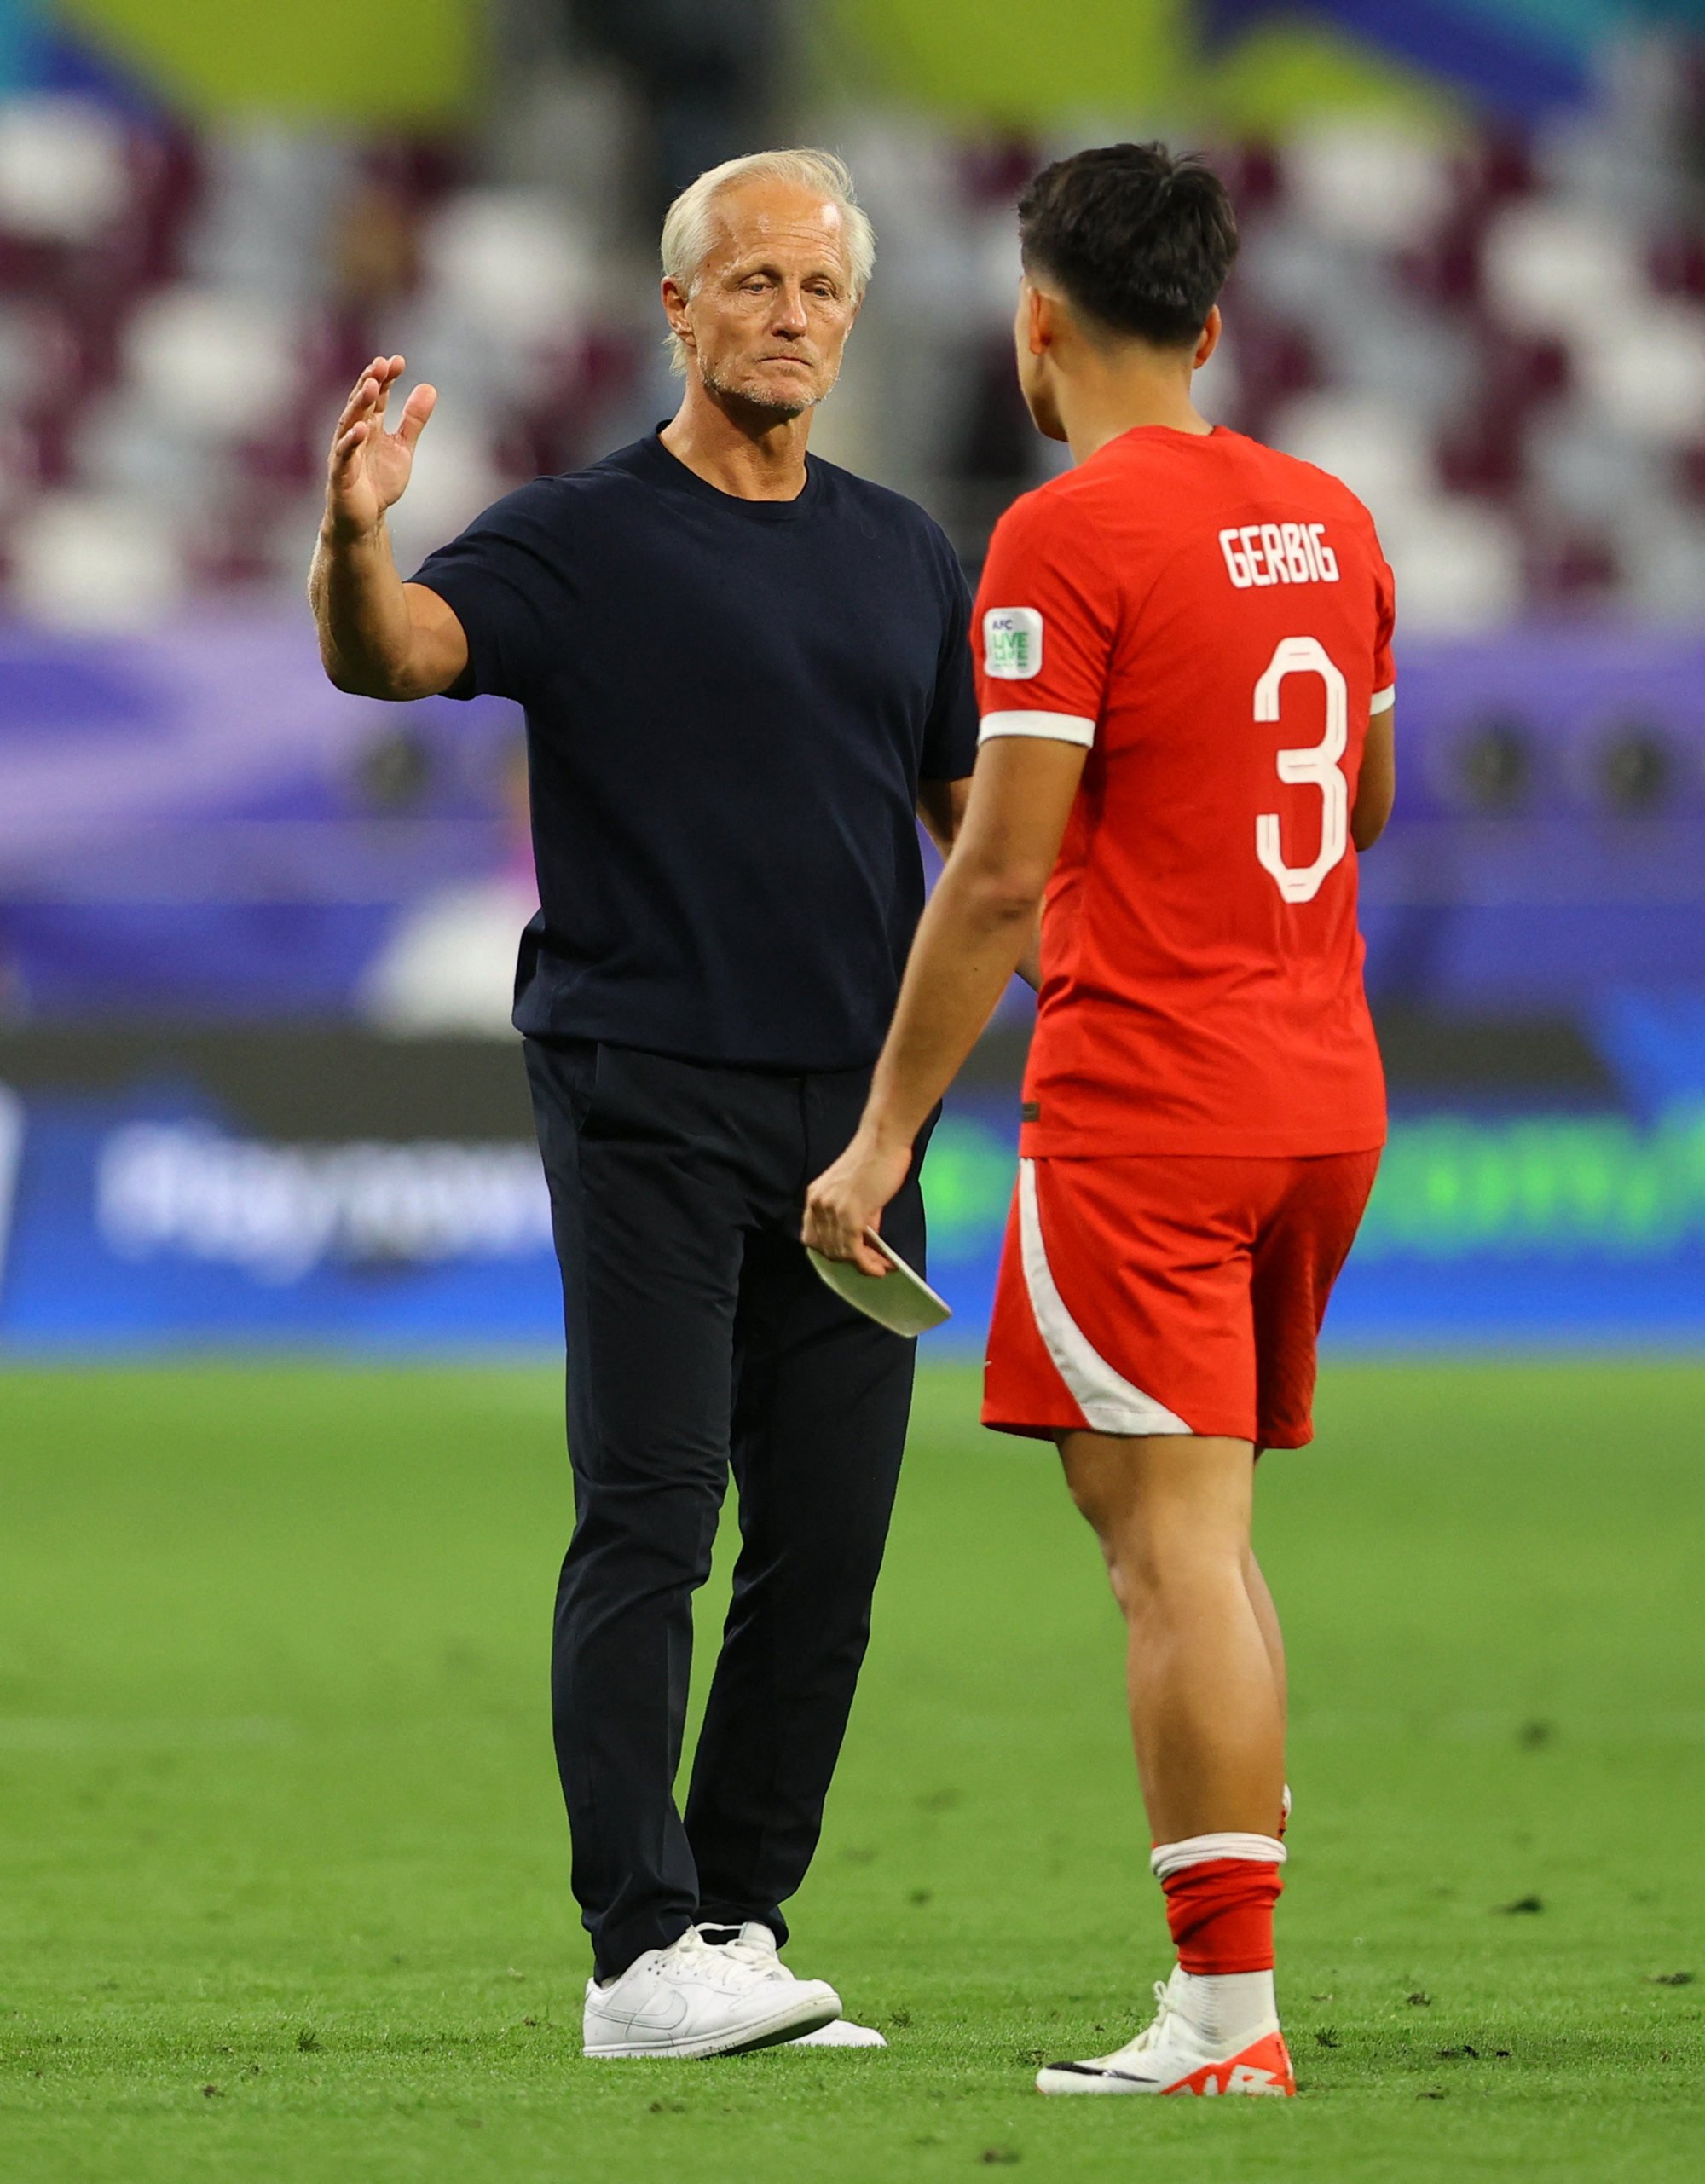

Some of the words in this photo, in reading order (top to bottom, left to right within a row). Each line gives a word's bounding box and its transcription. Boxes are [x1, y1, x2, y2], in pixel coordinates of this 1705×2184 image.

[1219, 523, 1339, 587] GERBIG
[992, 619, 1013, 630] AFC
[1253, 636, 1348, 903] 3
